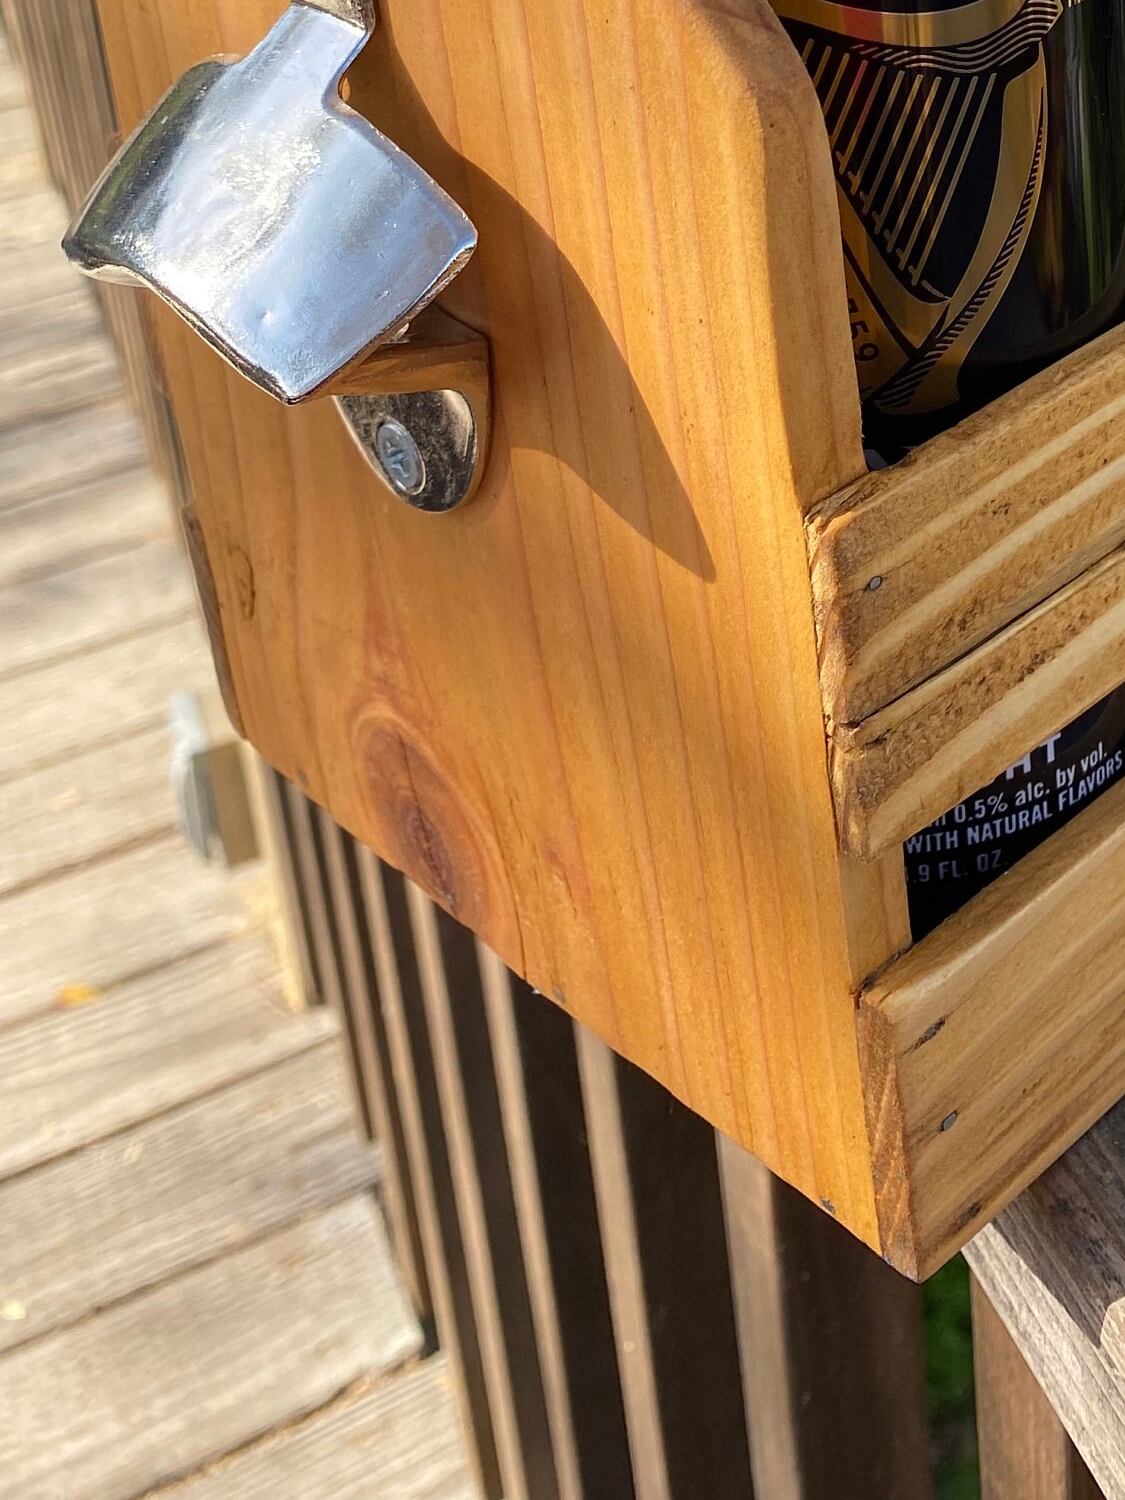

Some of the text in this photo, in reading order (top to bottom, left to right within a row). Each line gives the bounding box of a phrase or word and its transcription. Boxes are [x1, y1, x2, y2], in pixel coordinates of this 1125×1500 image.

[906, 749, 1123, 855] WITH NATURAL FLAVORS
[953, 791, 1009, 824] 0.5%
[1015, 781, 1051, 807] alc.
[1055, 763, 1076, 789] by
[1080, 741, 1108, 773] vol.
